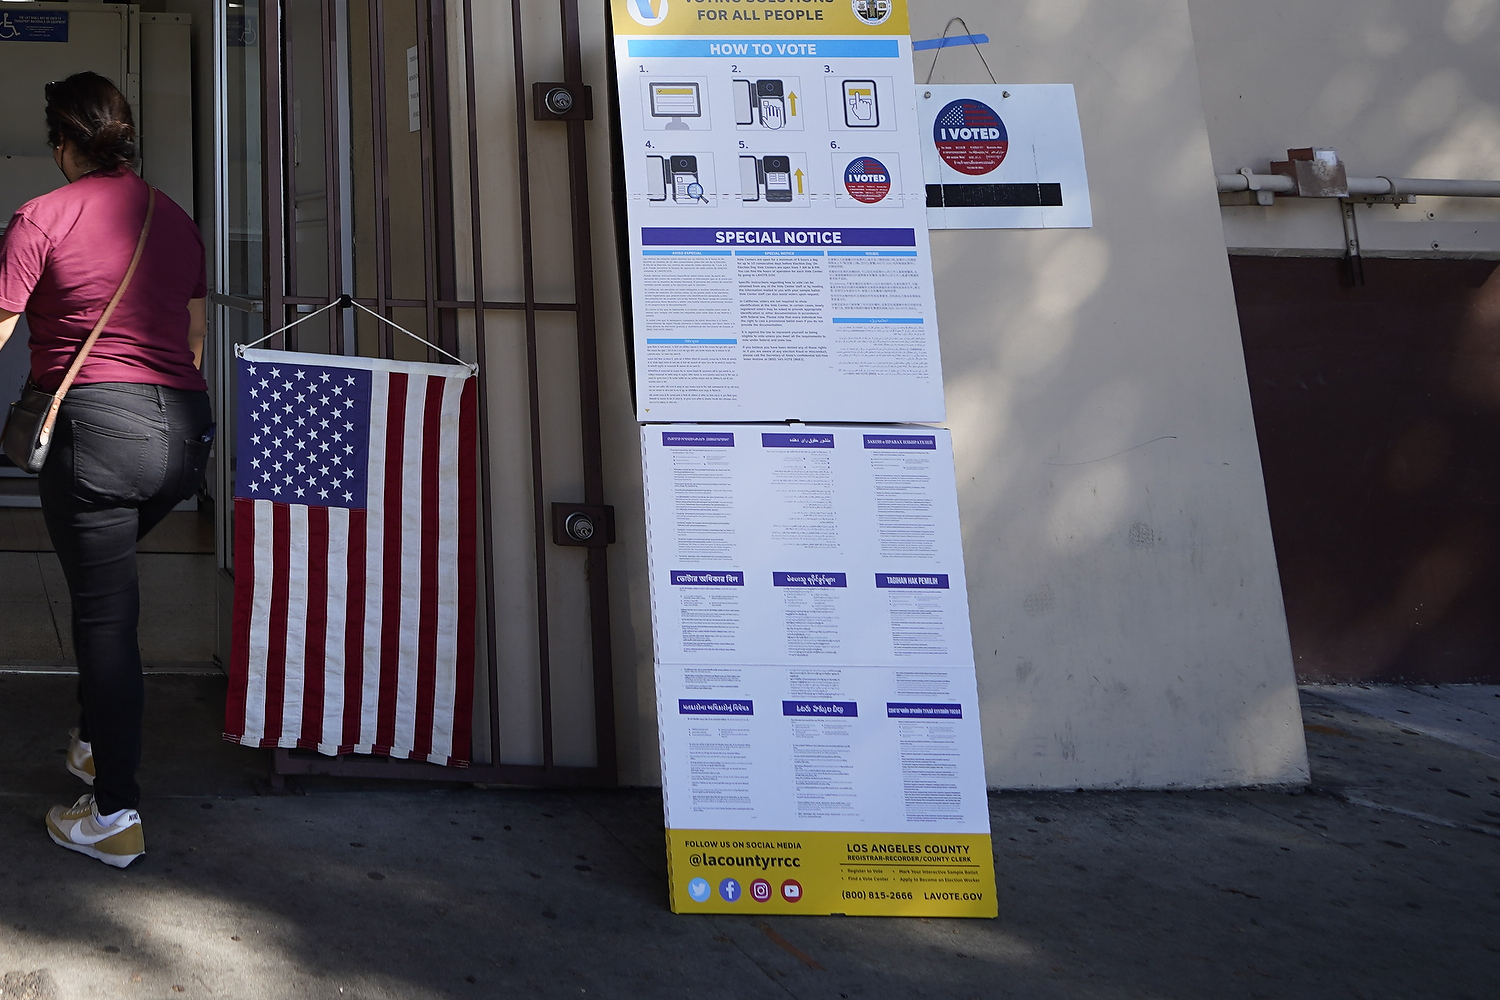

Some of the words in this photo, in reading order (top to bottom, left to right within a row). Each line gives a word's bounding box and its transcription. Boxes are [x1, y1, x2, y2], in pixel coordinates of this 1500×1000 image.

[697, 9, 729, 21] FOR
[732, 9, 761, 21] ALL
[764, 9, 824, 21] PEOPLE
[709, 43, 749, 55] HOW
[752, 43, 775, 55] TO
[777, 43, 817, 56] VOTE
[639, 65, 649, 73] 1.
[731, 65, 742, 73] 2.
[823, 65, 834, 73] 3.
[940, 128, 947, 140] I
[948, 128, 1000, 141] VOTED
[644, 140, 656, 149] 4.
[738, 140, 749, 149] 5.
[830, 140, 840, 149] 6.
[848, 174, 853, 182] I
[853, 174, 886, 183] VOTED
[715, 231, 781, 244] SPECIAL
[784, 231, 842, 244] NOTICE
[886, 576, 908, 584] TAGIHAN
[907, 576, 918, 584] HAK
[918, 576, 939, 585] PEMILIH
[684, 840, 718, 848] FOLLOW
[732, 841, 745, 849] ON
[746, 841, 775, 849] SOCIAL
[776, 842, 802, 850] MEDIA
[846, 843, 869, 853] LOS
[870, 844, 922, 854] ANGELES
[924, 844, 970, 855] COUNTY
[689, 852, 801, 871] @lacountyrrcc
[841, 889, 866, 900] (800)
[868, 891, 913, 900] 815-2666
[924, 892, 983, 901] LAVOTE.GOV
